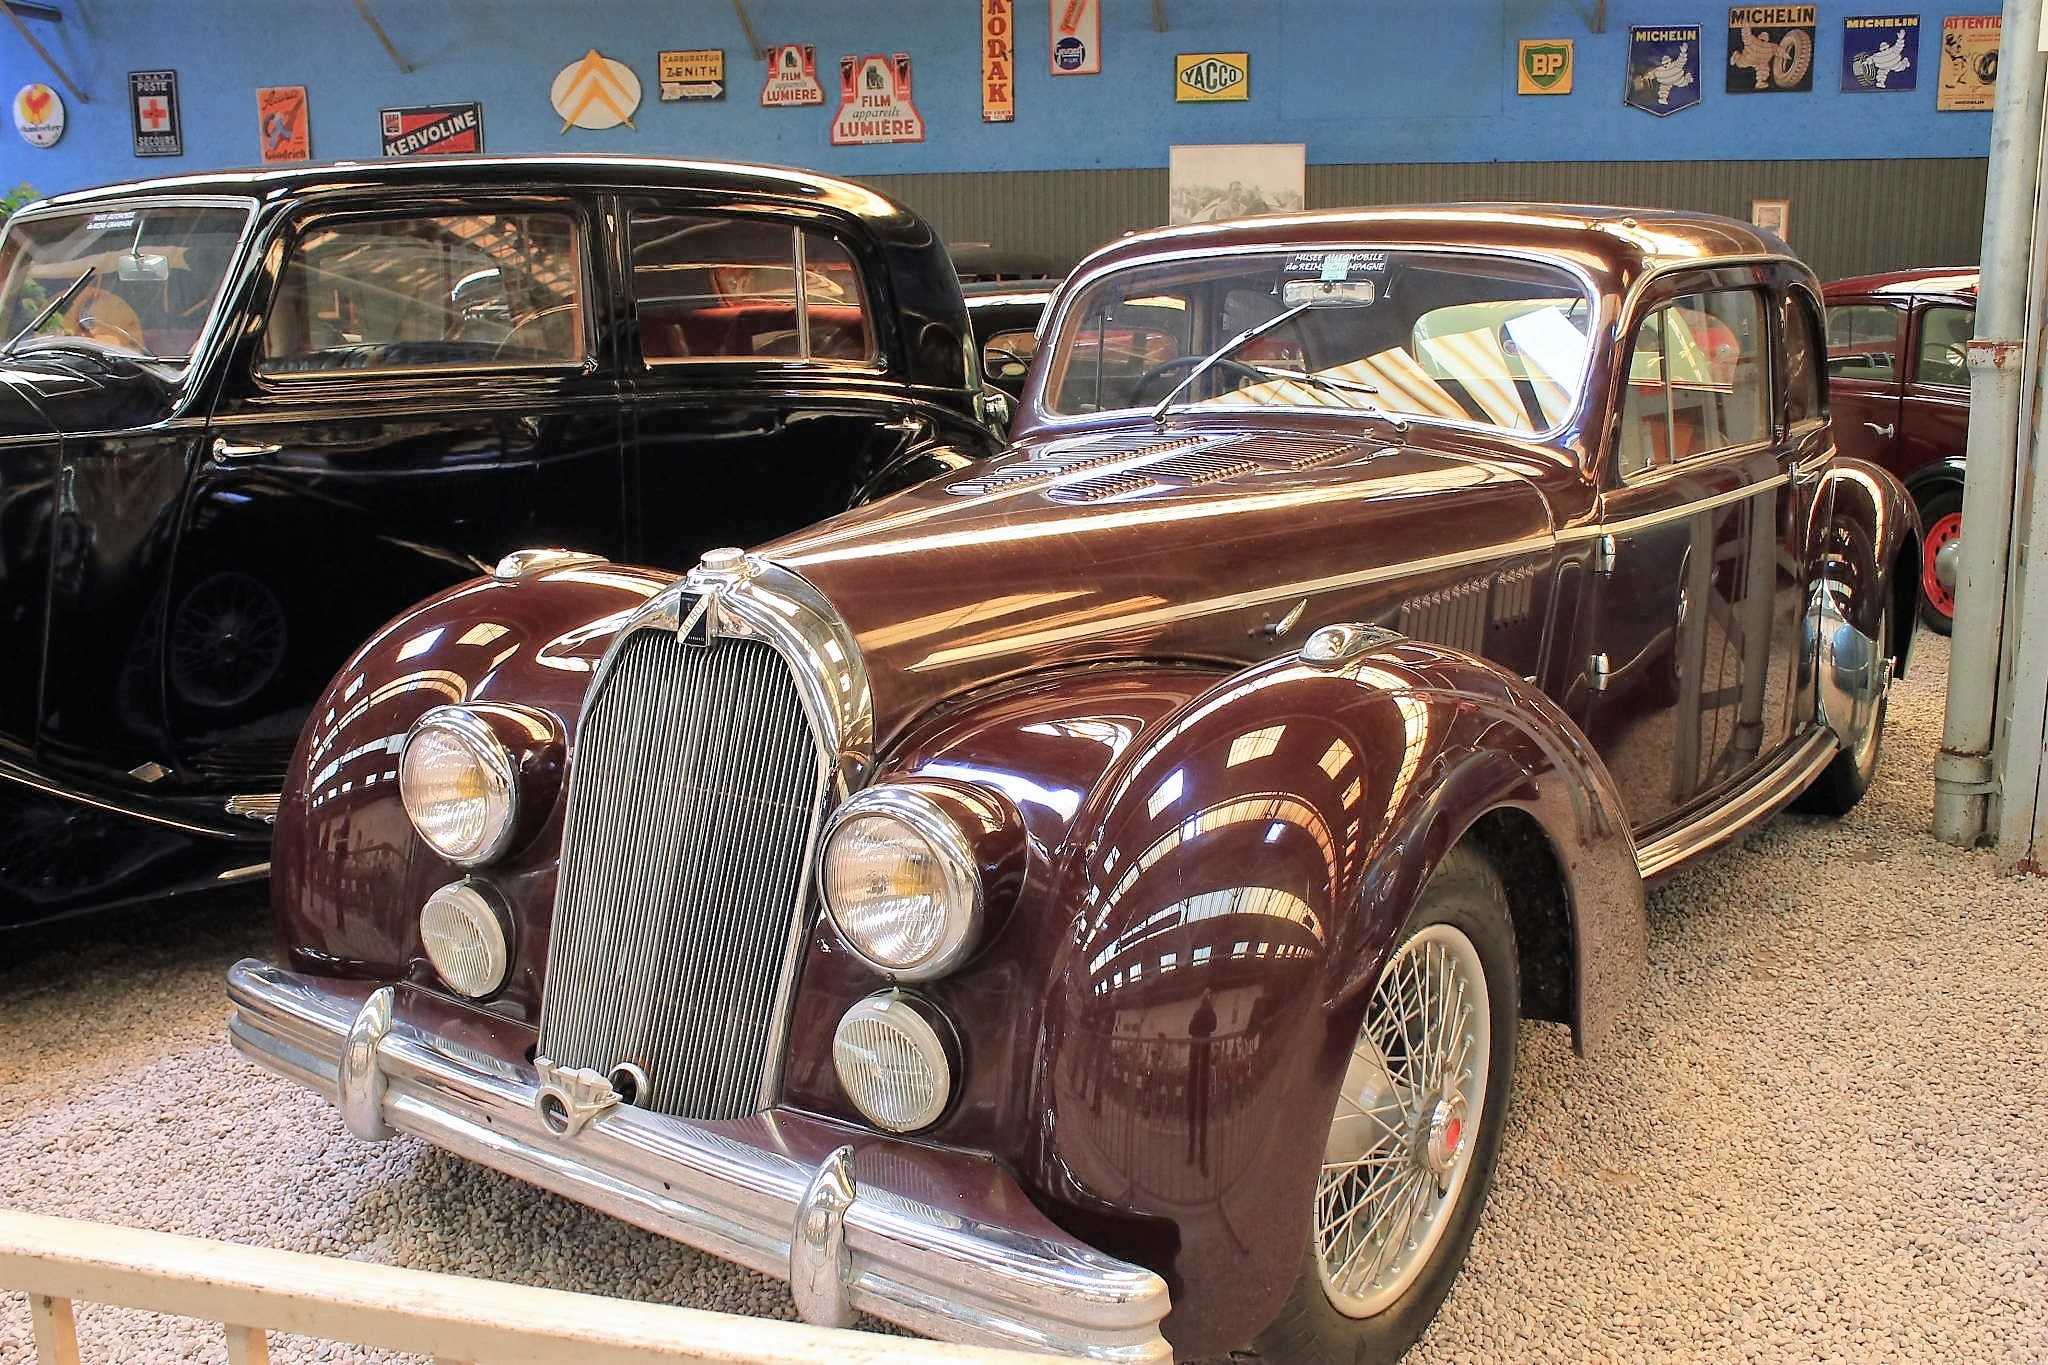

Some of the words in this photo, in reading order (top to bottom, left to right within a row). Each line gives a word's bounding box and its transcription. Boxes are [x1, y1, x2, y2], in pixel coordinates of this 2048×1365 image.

[1731, 8, 1814, 24] MICHELIN
[1846, 17, 1918, 28] MICHELIN
[1635, 30, 1697, 42] MICHELIN
[987, 0, 1008, 102] KODAK
[1531, 54, 1564, 77] BP
[666, 66, 717, 78] ZENITH
[781, 73, 801, 81] FILM
[1185, 61, 1237, 91] YACCO
[137, 82, 168, 93] POSTE
[862, 95, 891, 108] FILM
[853, 106, 900, 121] appareils
[385, 109, 478, 157] KERVOLINE
[138, 135, 176, 147] SECOURS
[1324, 253, 1385, 262] AUTOMOBILE
